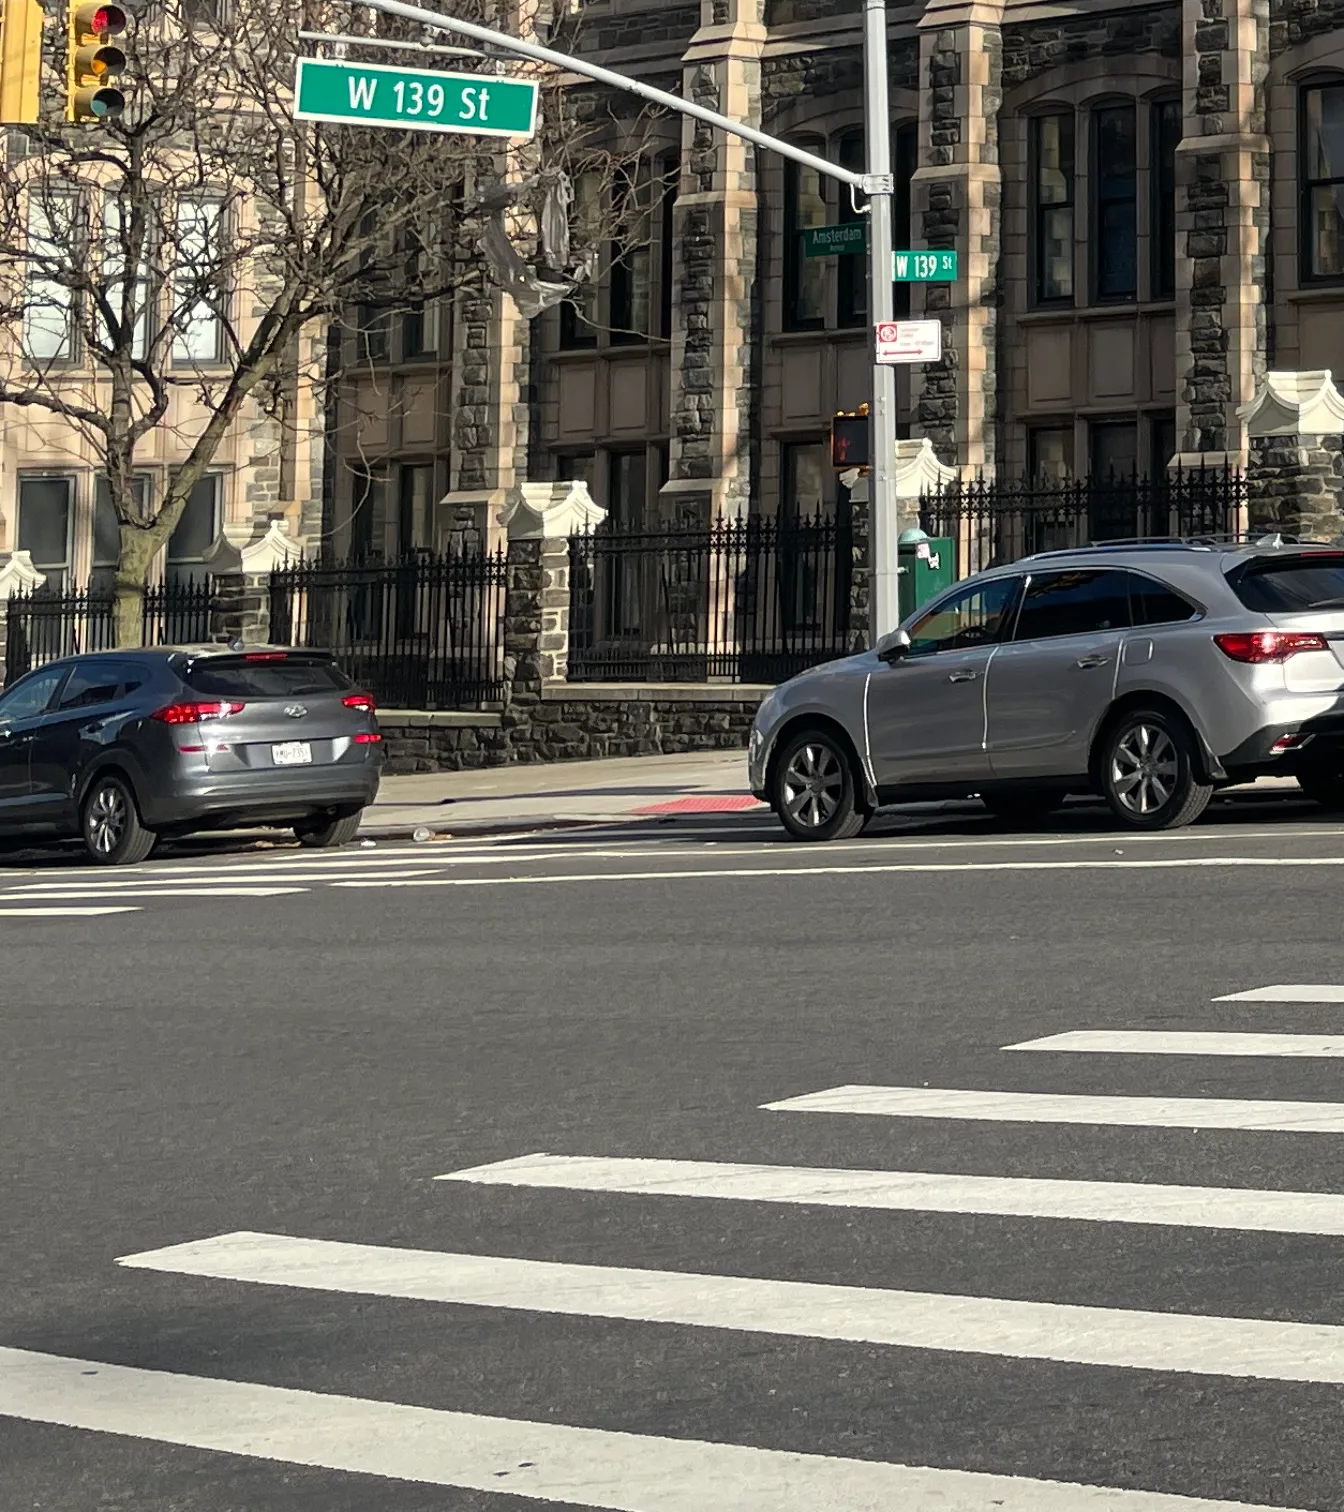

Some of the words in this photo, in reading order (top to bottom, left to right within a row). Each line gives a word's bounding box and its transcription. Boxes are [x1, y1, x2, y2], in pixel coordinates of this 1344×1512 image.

[348, 75, 377, 110] W
[393, 80, 444, 116] 139
[459, 88, 490, 120] St
[812, 227, 862, 244] Amsterdam
[896, 255, 908, 278] W
[914, 255, 937, 278] 139
[942, 255, 953, 270] St
